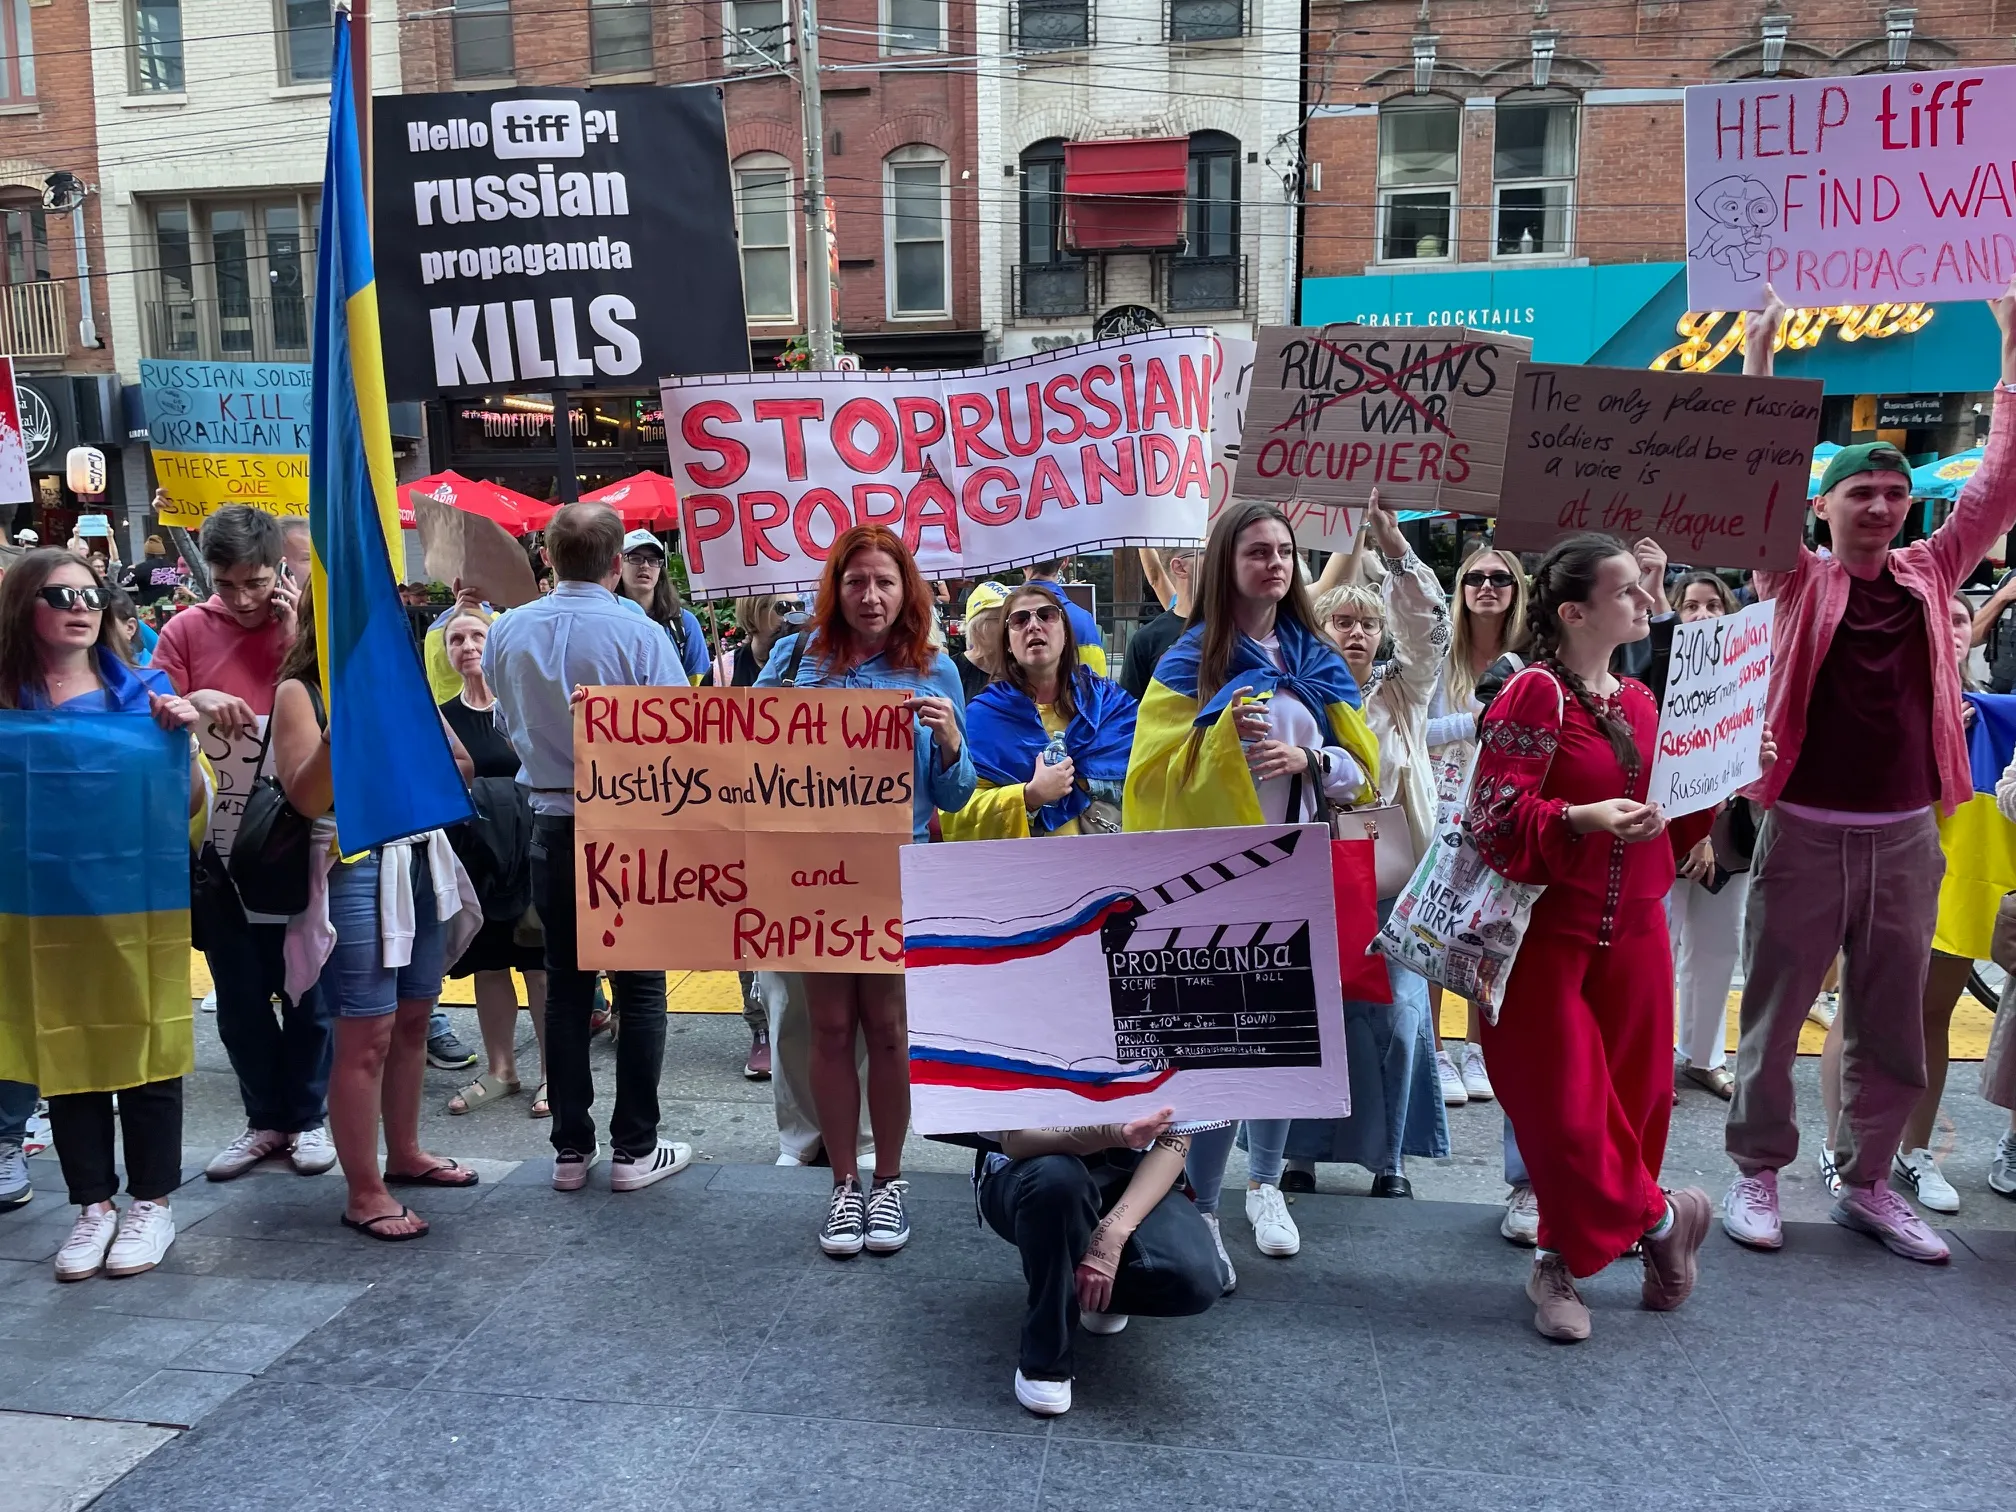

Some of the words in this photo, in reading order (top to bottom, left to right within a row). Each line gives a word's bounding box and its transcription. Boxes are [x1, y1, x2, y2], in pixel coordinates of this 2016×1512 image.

[407, 118, 489, 152] Hello
[1715, 85, 1849, 160] HELP
[1875, 78, 1984, 150] tiff
[413, 163, 629, 225] russian
[1918, 160, 2016, 219] WA
[420, 235, 632, 285] propaganda
[1356, 311, 1413, 326] CRAFT
[1428, 307, 1535, 326] COCKTAILS
[429, 293, 643, 386] KILLS
[140, 364, 245, 388] RUSSIAN
[1279, 340, 1499, 397] RUSSIANS
[219, 393, 294, 422] KILL
[1283, 392, 1335, 432] AT
[1360, 392, 1448, 435] WAR
[1524, 370, 1582, 413] The
[1599, 388, 1654, 425] only
[1663, 386, 1737, 422] place
[150, 420, 281, 447] UKRAINIAN
[1528, 423, 1614, 452] soldiers
[1628, 430, 1699, 460] should
[1705, 435, 1737, 461] be
[1745, 440, 1804, 475] given
[158, 457, 230, 479] THERE
[237, 459, 266, 479] IS
[1256, 438, 1471, 483] OCCUPIERS
[1545, 456, 1560, 477] a
[1574, 460, 1621, 480] voice
[1638, 461, 1661, 485] is
[226, 479, 272, 494] ONE
[163, 498, 211, 517] SIDE
[1557, 488, 1593, 528] at
[1601, 490, 1644, 532] the
[1658, 723, 1711, 764] Russian
[718, 777, 754, 805] and
[791, 860, 860, 887] and
[1426, 880, 1472, 916] NEW
[1417, 894, 1464, 939] YORK
[1120, 978, 1157, 991] SCENE
[1185, 977, 1215, 987] TAKE
[1255, 972, 1284, 982] ROLL
[1140, 993, 1153, 1013] 1
[1240, 1014, 1276, 1026] SOUND
[1117, 1019, 1142, 1031] DATE
